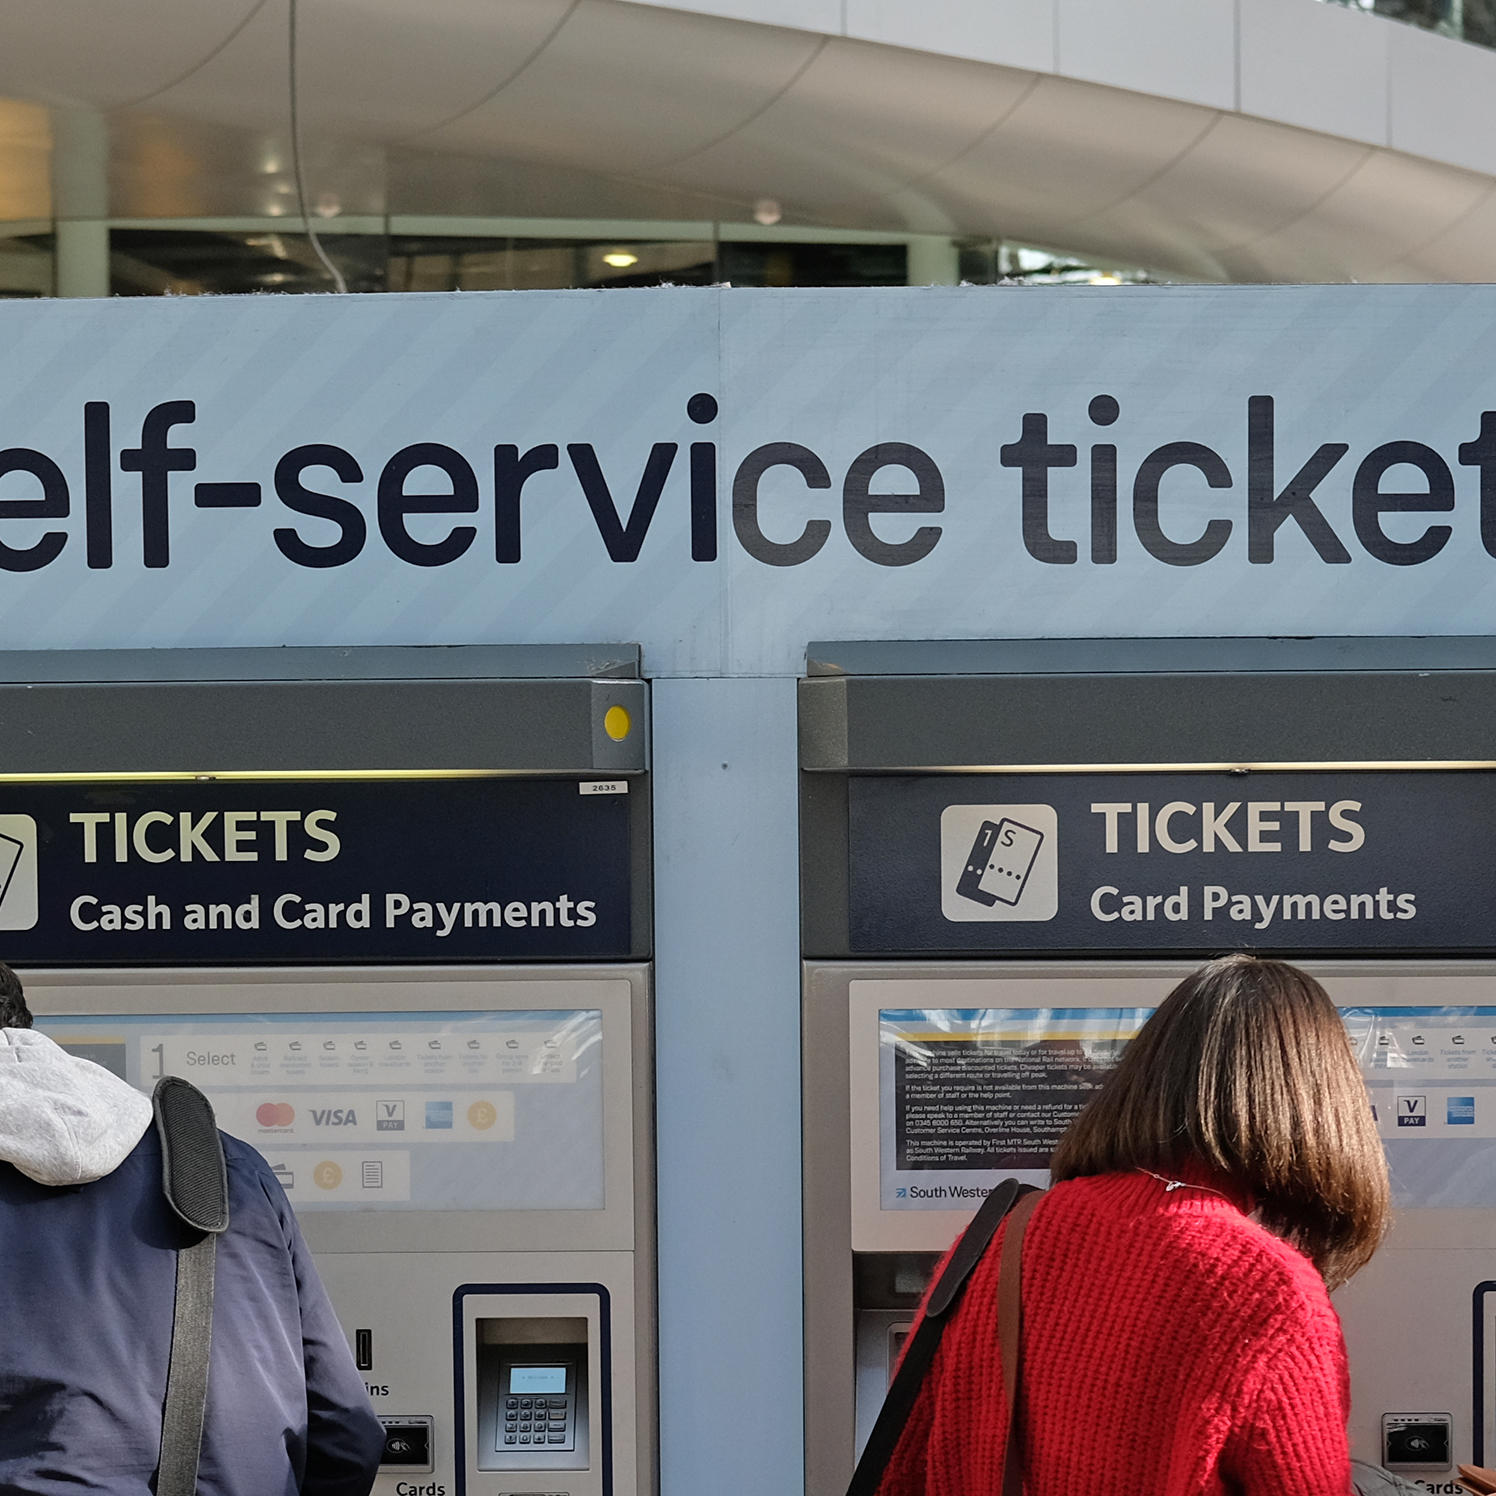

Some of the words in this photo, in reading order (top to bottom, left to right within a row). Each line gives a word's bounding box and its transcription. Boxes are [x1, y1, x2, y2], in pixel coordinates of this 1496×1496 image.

[1091, 800, 1365, 853] TICKETS
[70, 810, 340, 863] TICKETS
[71, 896, 170, 930] Cash
[184, 895, 259, 929] and
[274, 894, 370, 929] Card
[386, 894, 597, 936] Payments
[1091, 886, 1188, 921] Card
[1204, 886, 1416, 929] Payments
[186, 1051, 236, 1066] Select
[381, 1103, 397, 1118] V
[1403, 1099, 1419, 1113] V
[308, 1109, 358, 1126] VISA
[1403, 1117, 1420, 1125] PAY
[910, 1186, 946, 1199] South
[949, 1186, 992, 1198] Wester
[365, 1382, 389, 1397] ins
[396, 1482, 446, 1496] Cards
